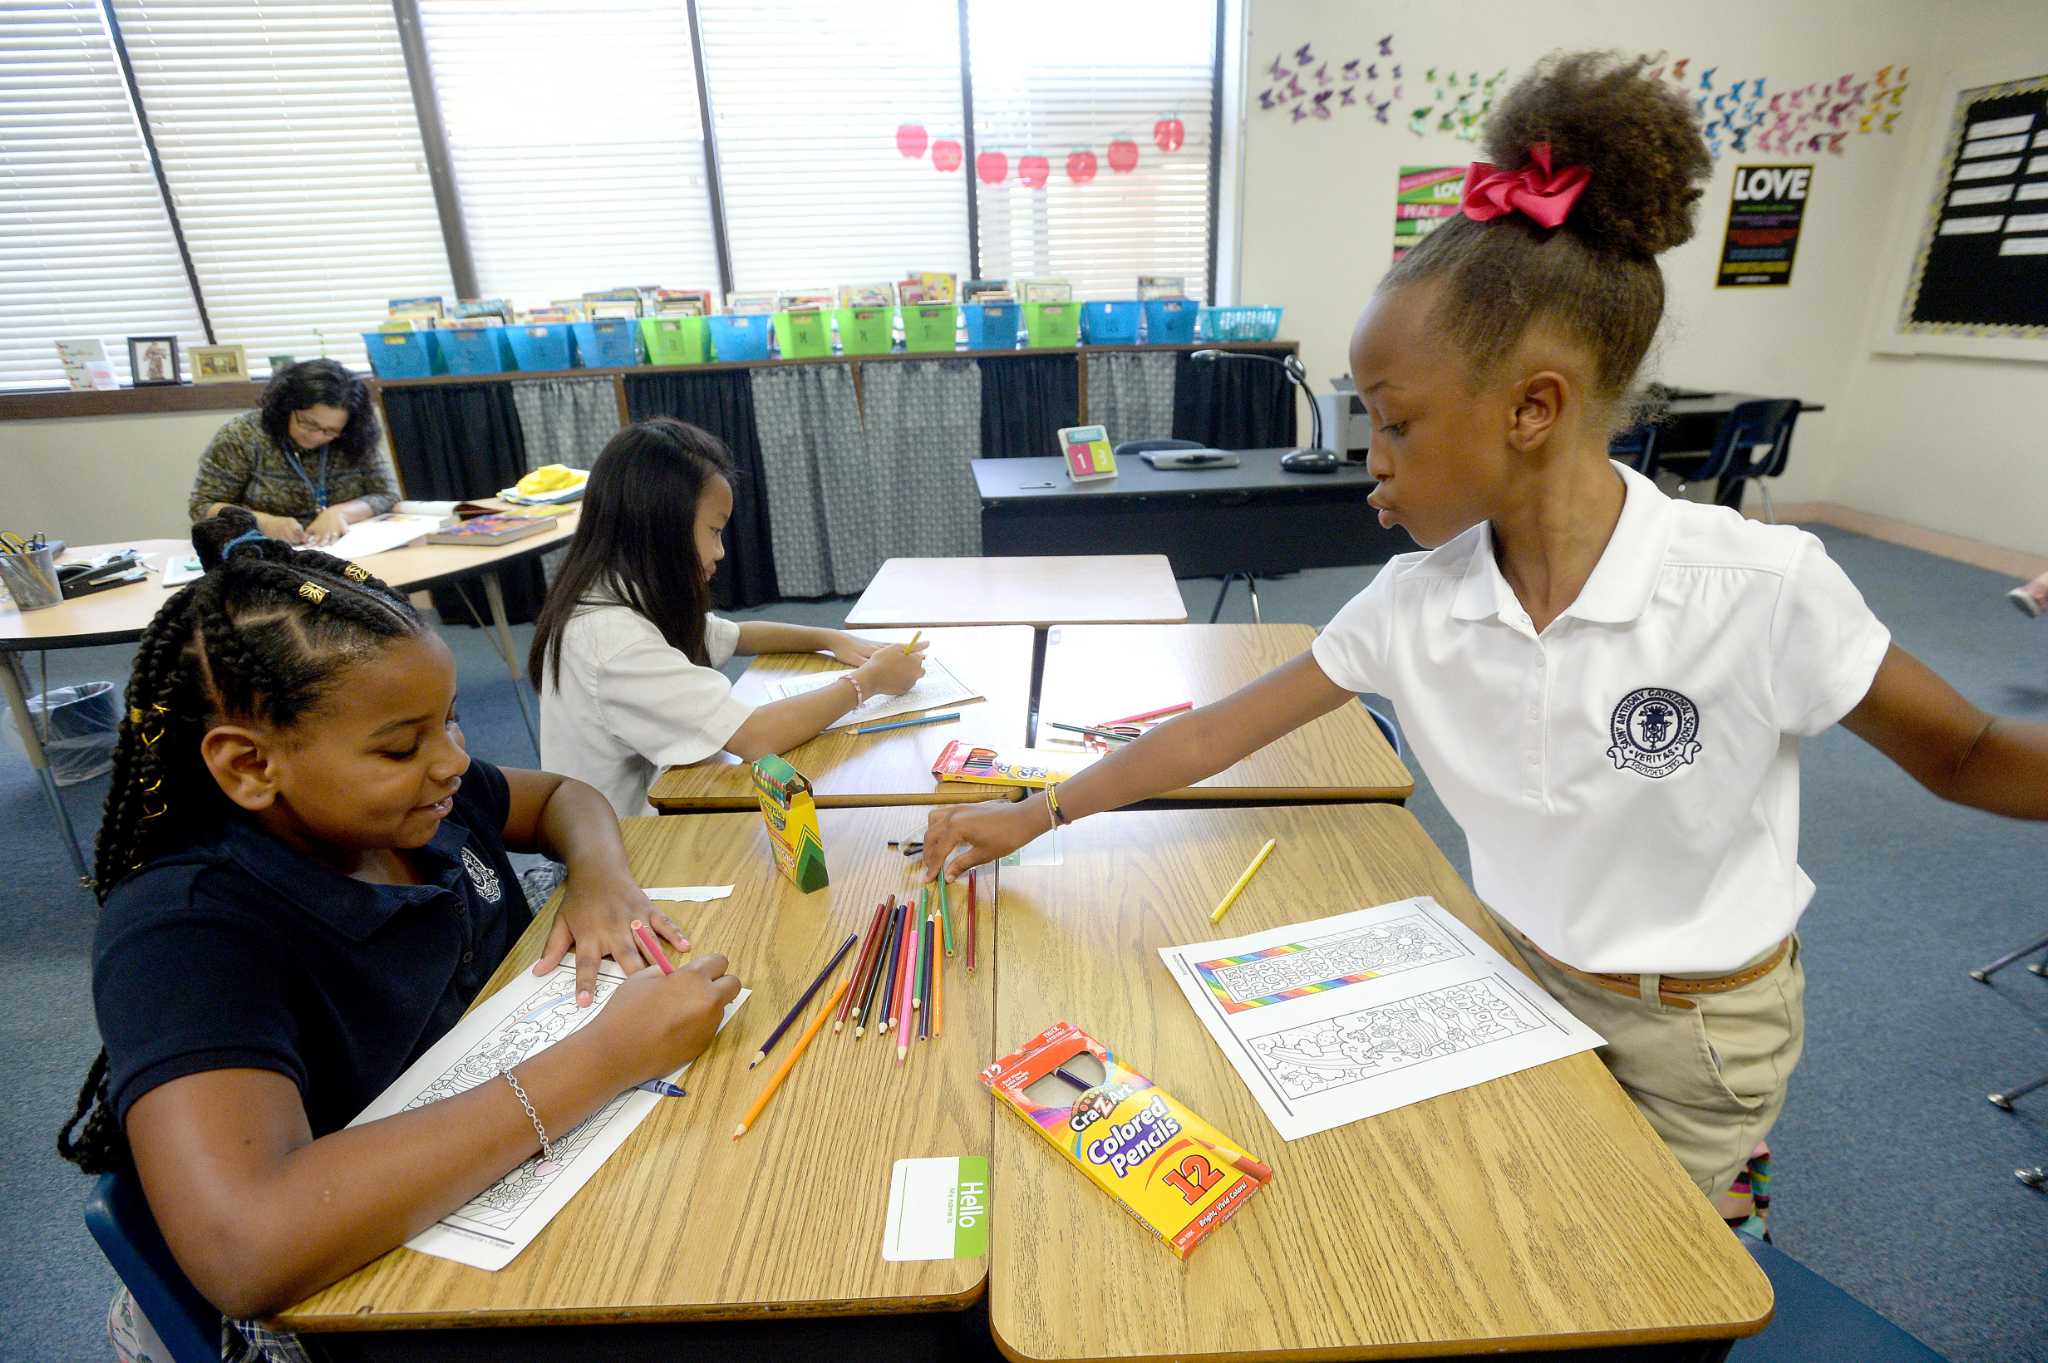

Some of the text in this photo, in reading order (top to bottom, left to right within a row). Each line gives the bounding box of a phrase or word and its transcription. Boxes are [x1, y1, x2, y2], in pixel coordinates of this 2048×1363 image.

[1433, 182, 1463, 199] LOV
[1735, 168, 1810, 200] LOVE
[1616, 690, 1695, 749] SAINT ANTHONY CATHEDRAL SCHOOL
[1634, 749, 1675, 764] VERITAS
[1088, 1095, 1168, 1165] Colored
[1111, 1118, 1182, 1178] Pencils
[1162, 1154, 1226, 1206] 12
[960, 1182, 984, 1228] Hello
[1199, 1210, 1218, 1228] Bright,
[1216, 1196, 1231, 1211] Vivid
